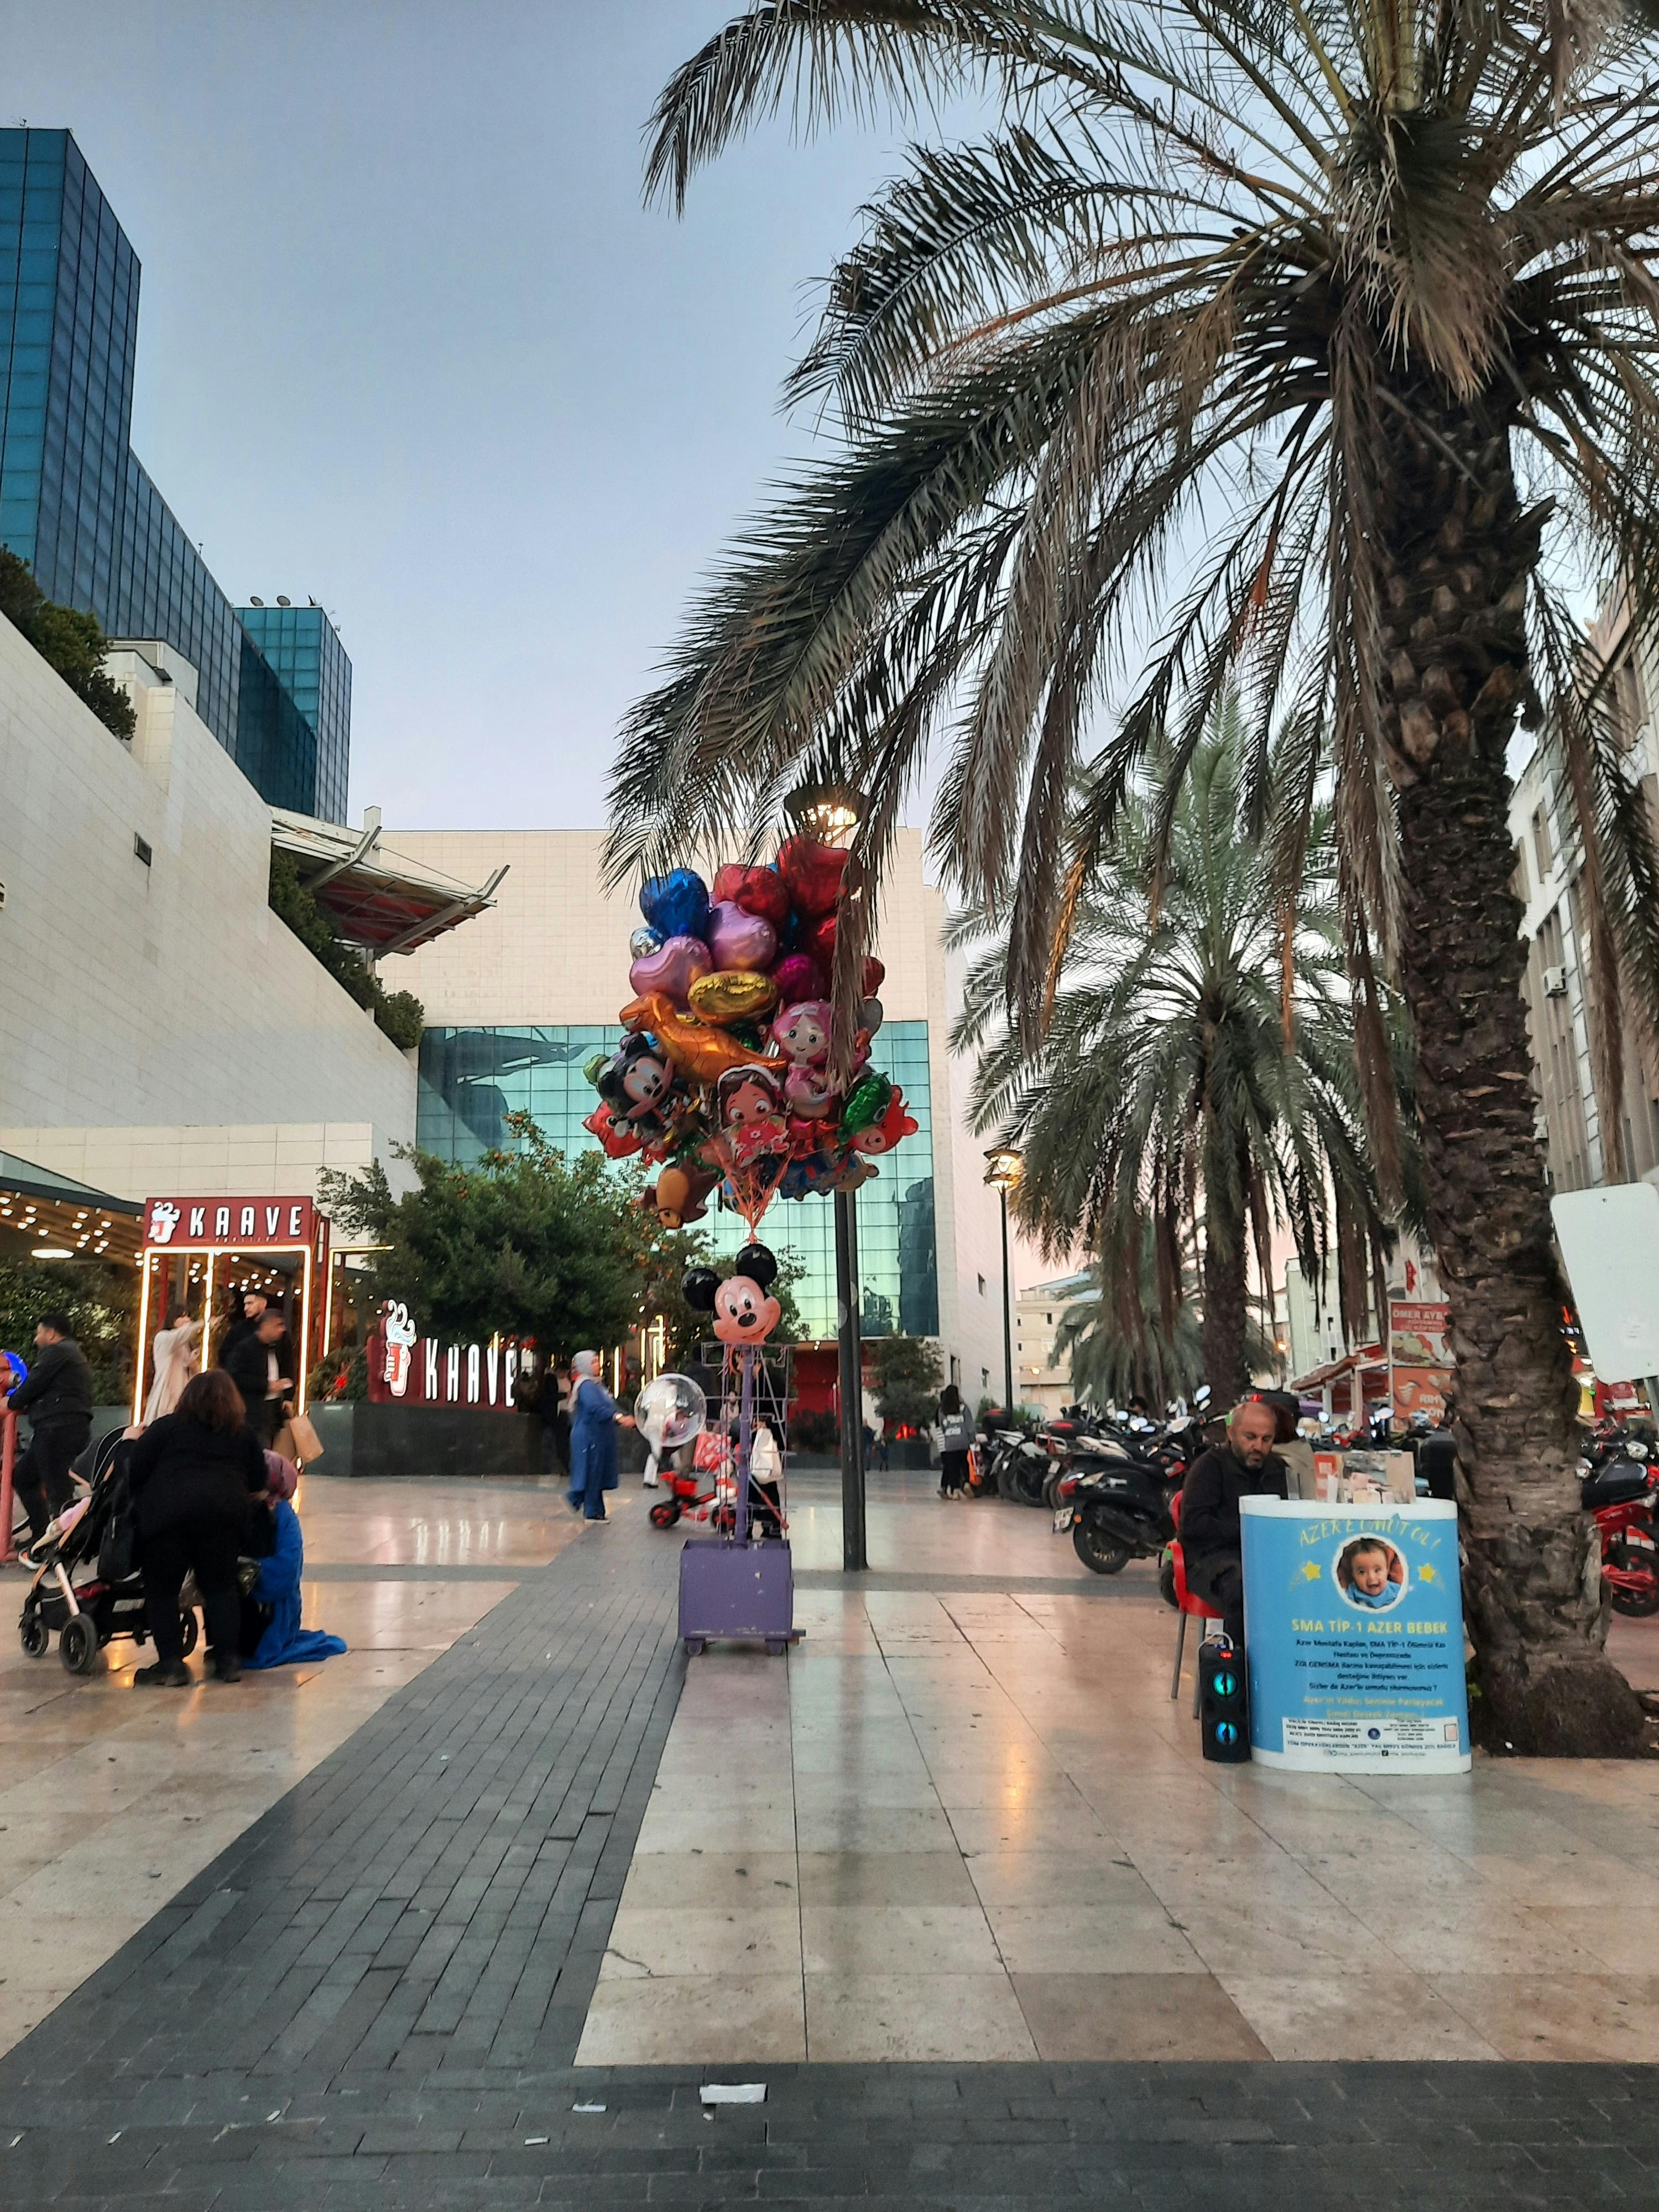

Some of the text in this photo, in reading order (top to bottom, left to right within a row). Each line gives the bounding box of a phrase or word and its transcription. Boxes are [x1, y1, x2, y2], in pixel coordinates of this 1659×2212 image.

[189, 1206, 303, 1237] KAAVE
[1291, 1619, 1324, 1632] SMA
[1367, 1621, 1403, 1634] AZER
[1406, 1621, 1448, 1635] BEBEK
